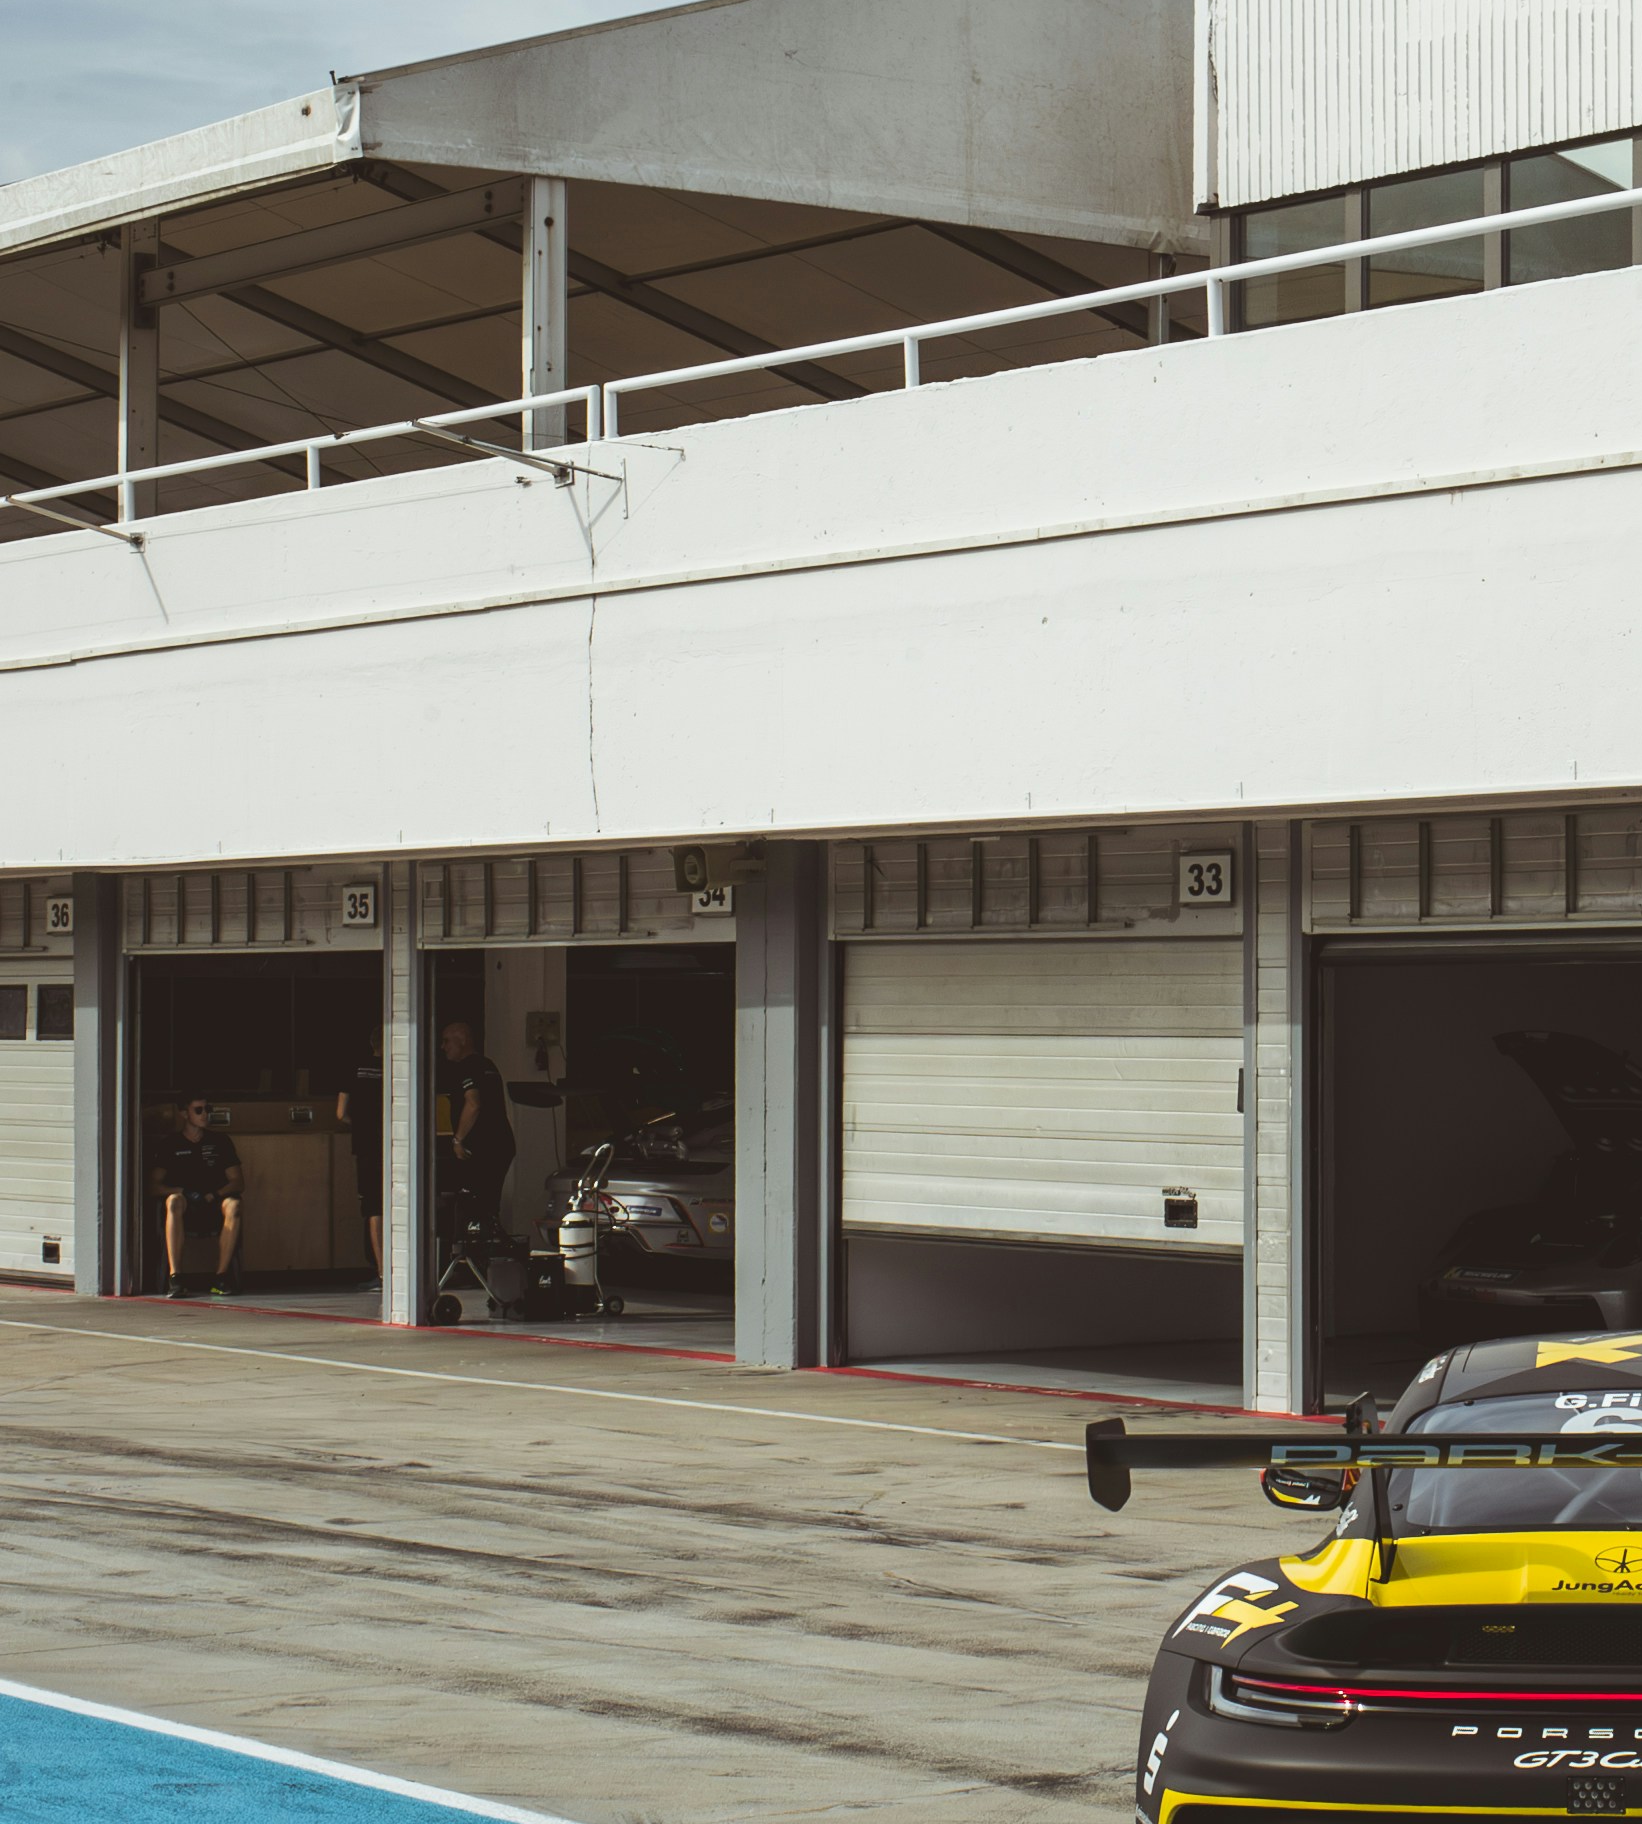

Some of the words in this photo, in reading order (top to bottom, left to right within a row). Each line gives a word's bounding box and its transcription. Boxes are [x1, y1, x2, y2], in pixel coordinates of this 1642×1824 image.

[1187, 861, 1224, 897] 33
[51, 902, 70, 928] 36
[346, 891, 370, 920] 35
